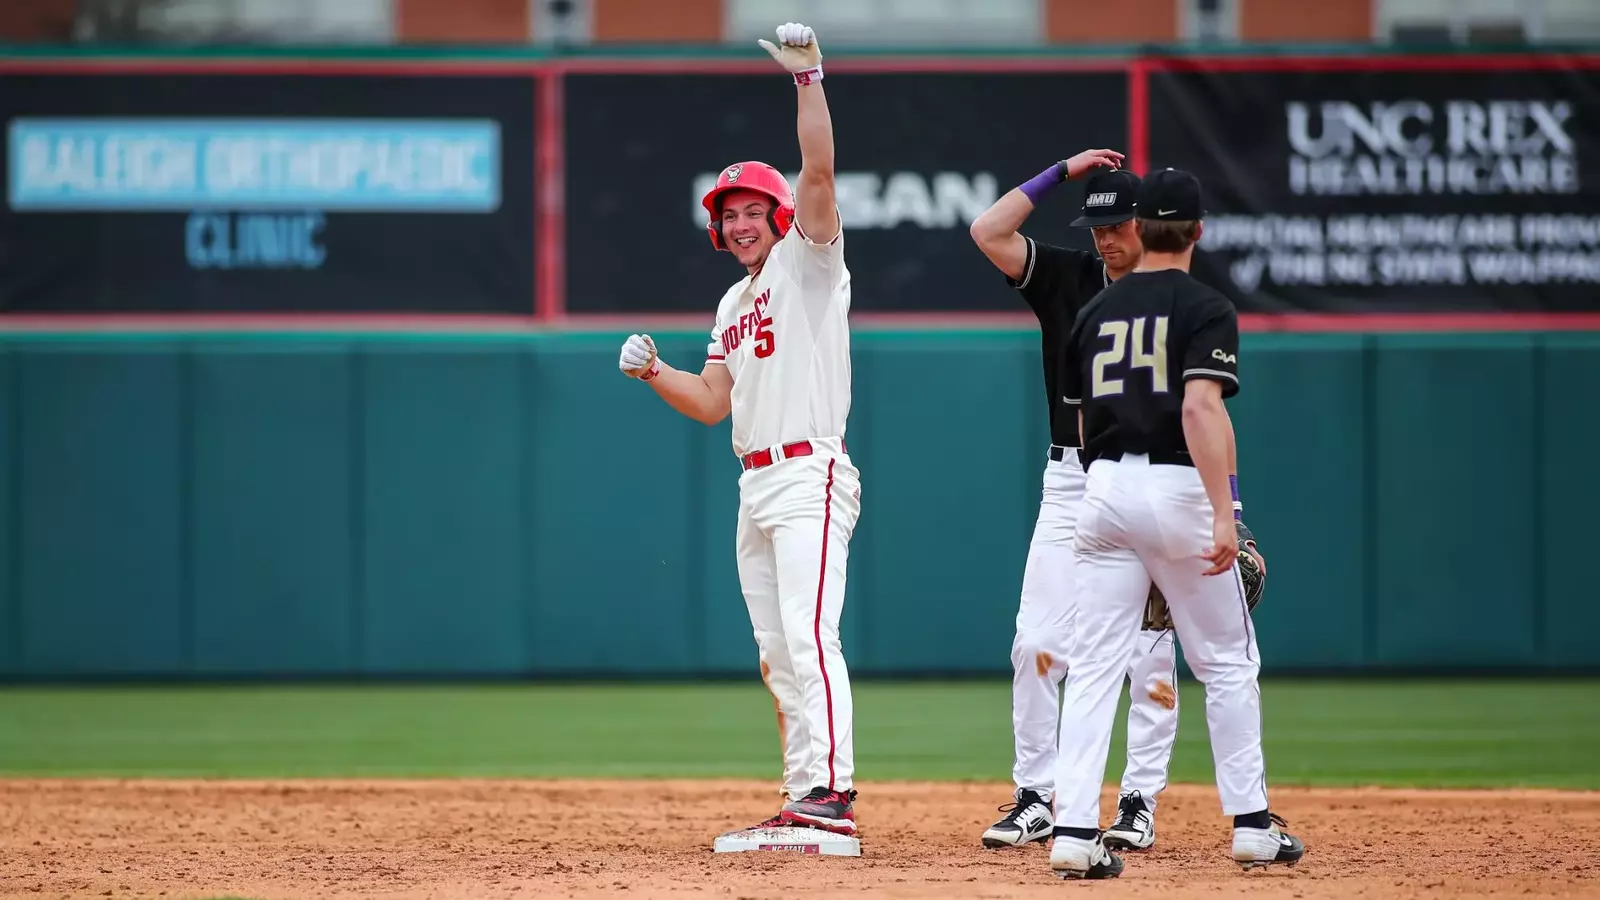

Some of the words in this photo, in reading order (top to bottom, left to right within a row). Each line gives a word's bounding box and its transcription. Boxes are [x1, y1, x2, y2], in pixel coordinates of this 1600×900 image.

[1287, 101, 1434, 158] UNC
[1446, 102, 1577, 157] REX
[1086, 193, 1116, 206] JMU
[1288, 156, 1579, 195] HEALTHCARE
[185, 210, 326, 268] CLINIC
[754, 316, 776, 359] 5
[1091, 315, 1169, 398] 24
